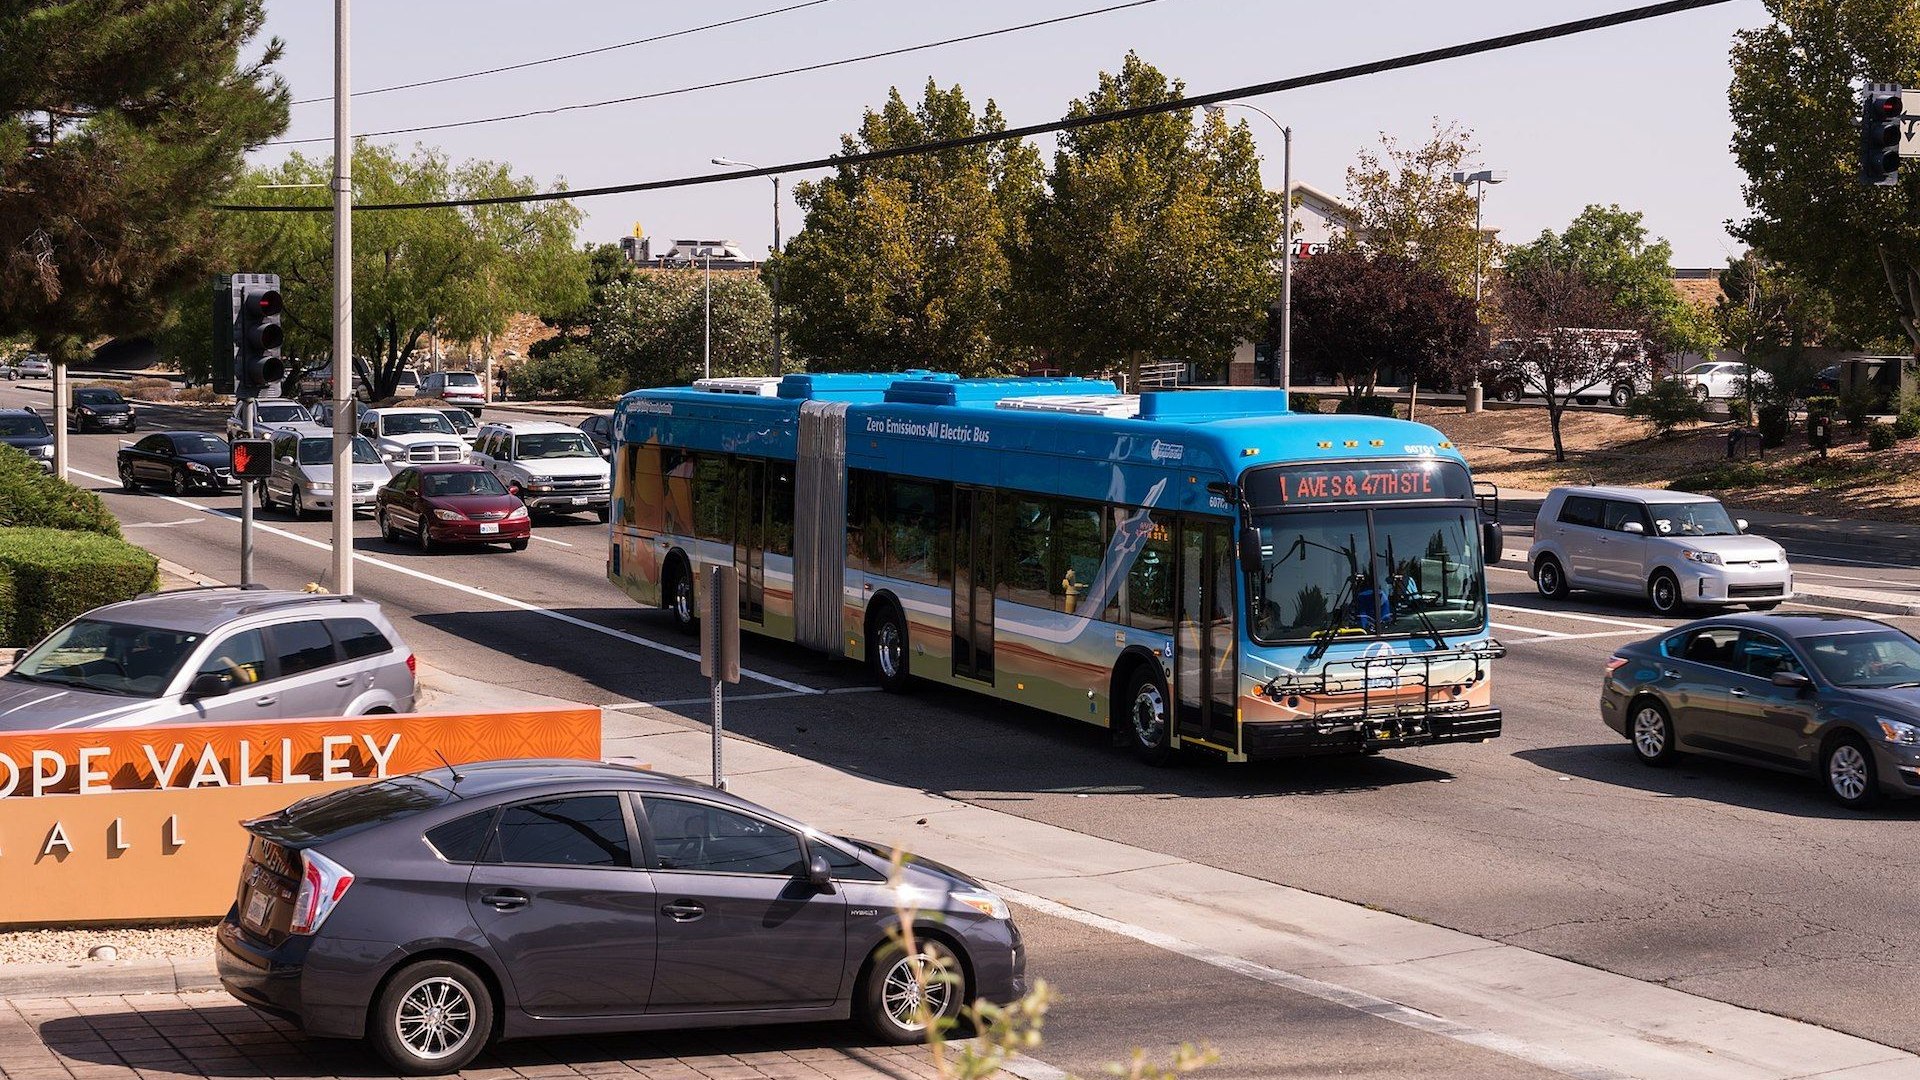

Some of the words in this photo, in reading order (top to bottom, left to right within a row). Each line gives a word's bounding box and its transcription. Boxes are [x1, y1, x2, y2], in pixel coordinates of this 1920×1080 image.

[866, 417, 884, 432] Zero
[940, 424, 971, 442] Electric
[973, 427, 989, 442] Bus
[1297, 475, 1328, 498] AVE
[1331, 475, 1342, 496] S
[1344, 474, 1358, 496] &
[1361, 473, 1398, 495] 47TH
[1401, 472, 1420, 494] ST
[1423, 471, 1432, 493] E
[142, 733, 401, 791] VALLEY
[0, 814, 186, 856] ALL
